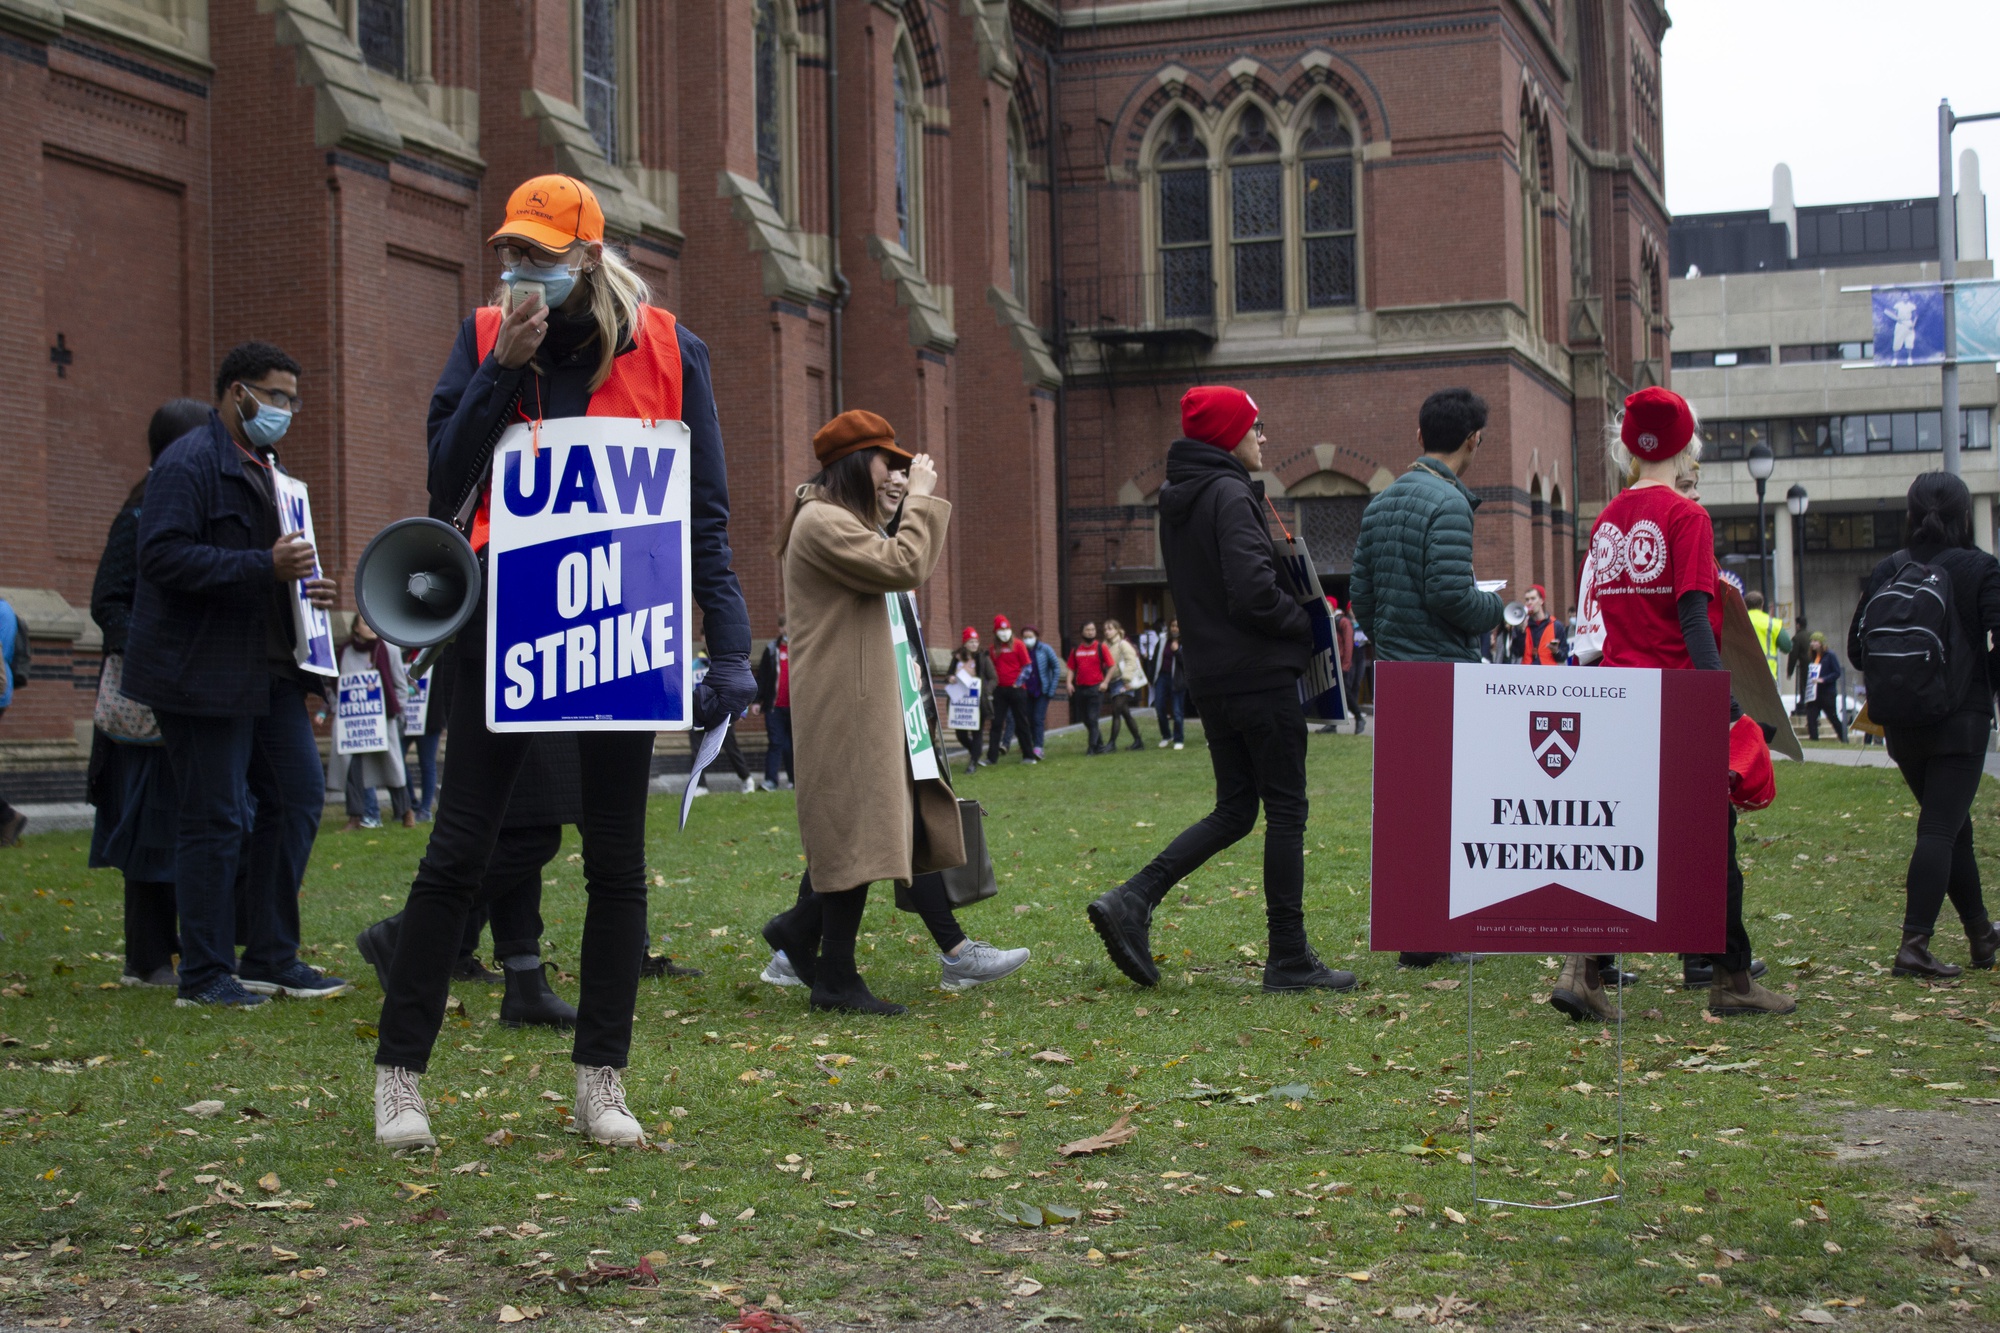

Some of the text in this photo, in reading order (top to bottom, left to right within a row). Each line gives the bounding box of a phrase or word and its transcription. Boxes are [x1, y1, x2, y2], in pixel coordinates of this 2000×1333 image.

[530, 209, 554, 221] DEERE
[503, 445, 676, 517] UAW
[556, 542, 621, 619] ON
[504, 602, 675, 710] STRIKE
[341, 673, 378, 686] UAW
[349, 689, 368, 701] ON
[1485, 683, 1627, 699] HARVARD COLLEGE
[340, 701, 381, 716] STRIKE
[344, 718, 377, 729] UNFAIR
[346, 729, 376, 739] LABOR
[341, 738, 383, 749] PRACTICE
[1490, 798, 1621, 827] FAMILY
[1461, 842, 1645, 872] WEEKEND
[1509, 925, 1537, 933] College
